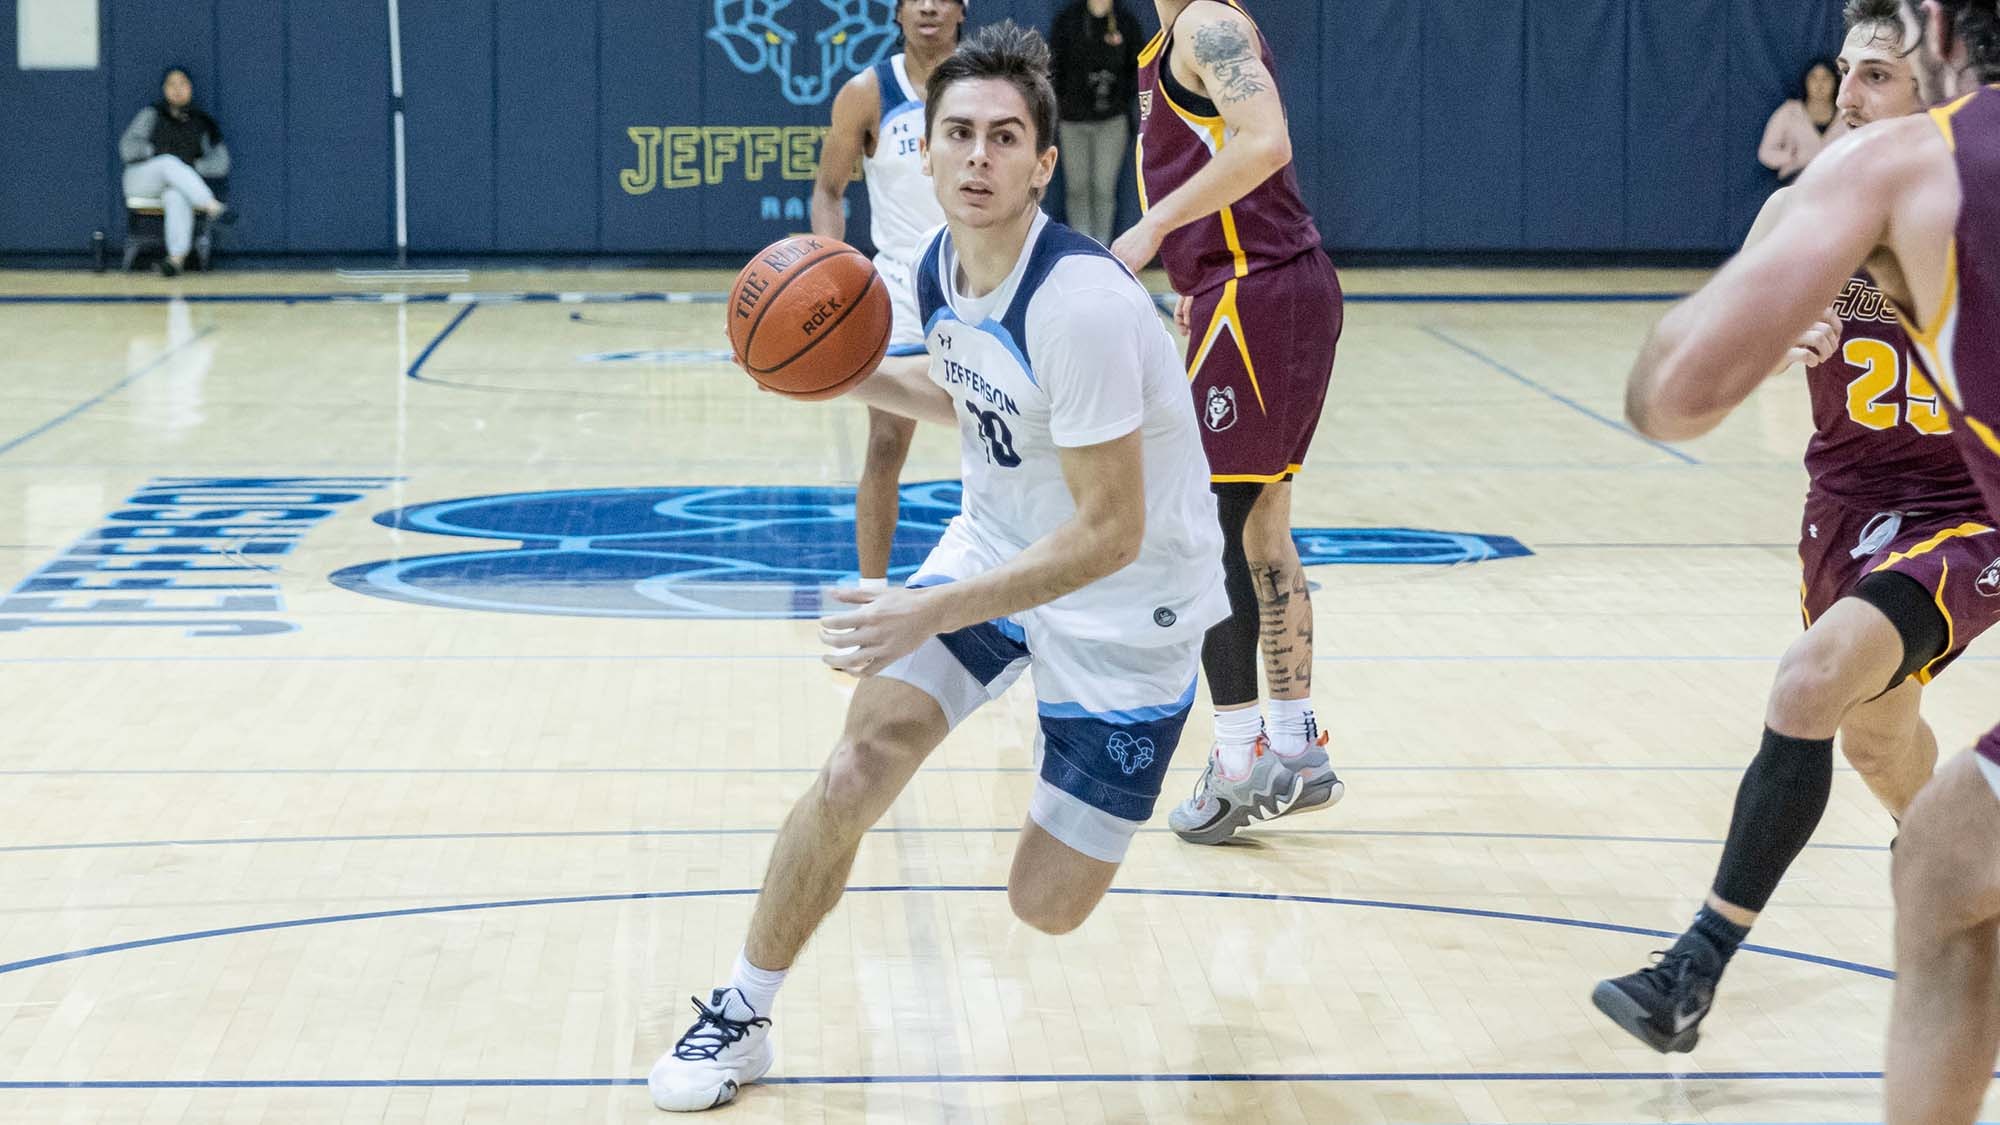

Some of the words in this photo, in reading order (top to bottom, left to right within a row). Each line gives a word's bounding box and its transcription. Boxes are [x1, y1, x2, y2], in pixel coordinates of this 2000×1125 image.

[761, 196, 851, 220] RA
[736, 272, 769, 319] THE
[802, 297, 843, 336] ROCK
[943, 358, 1021, 416] JEFFERSON
[0, 477, 411, 637] JEFFERSON
